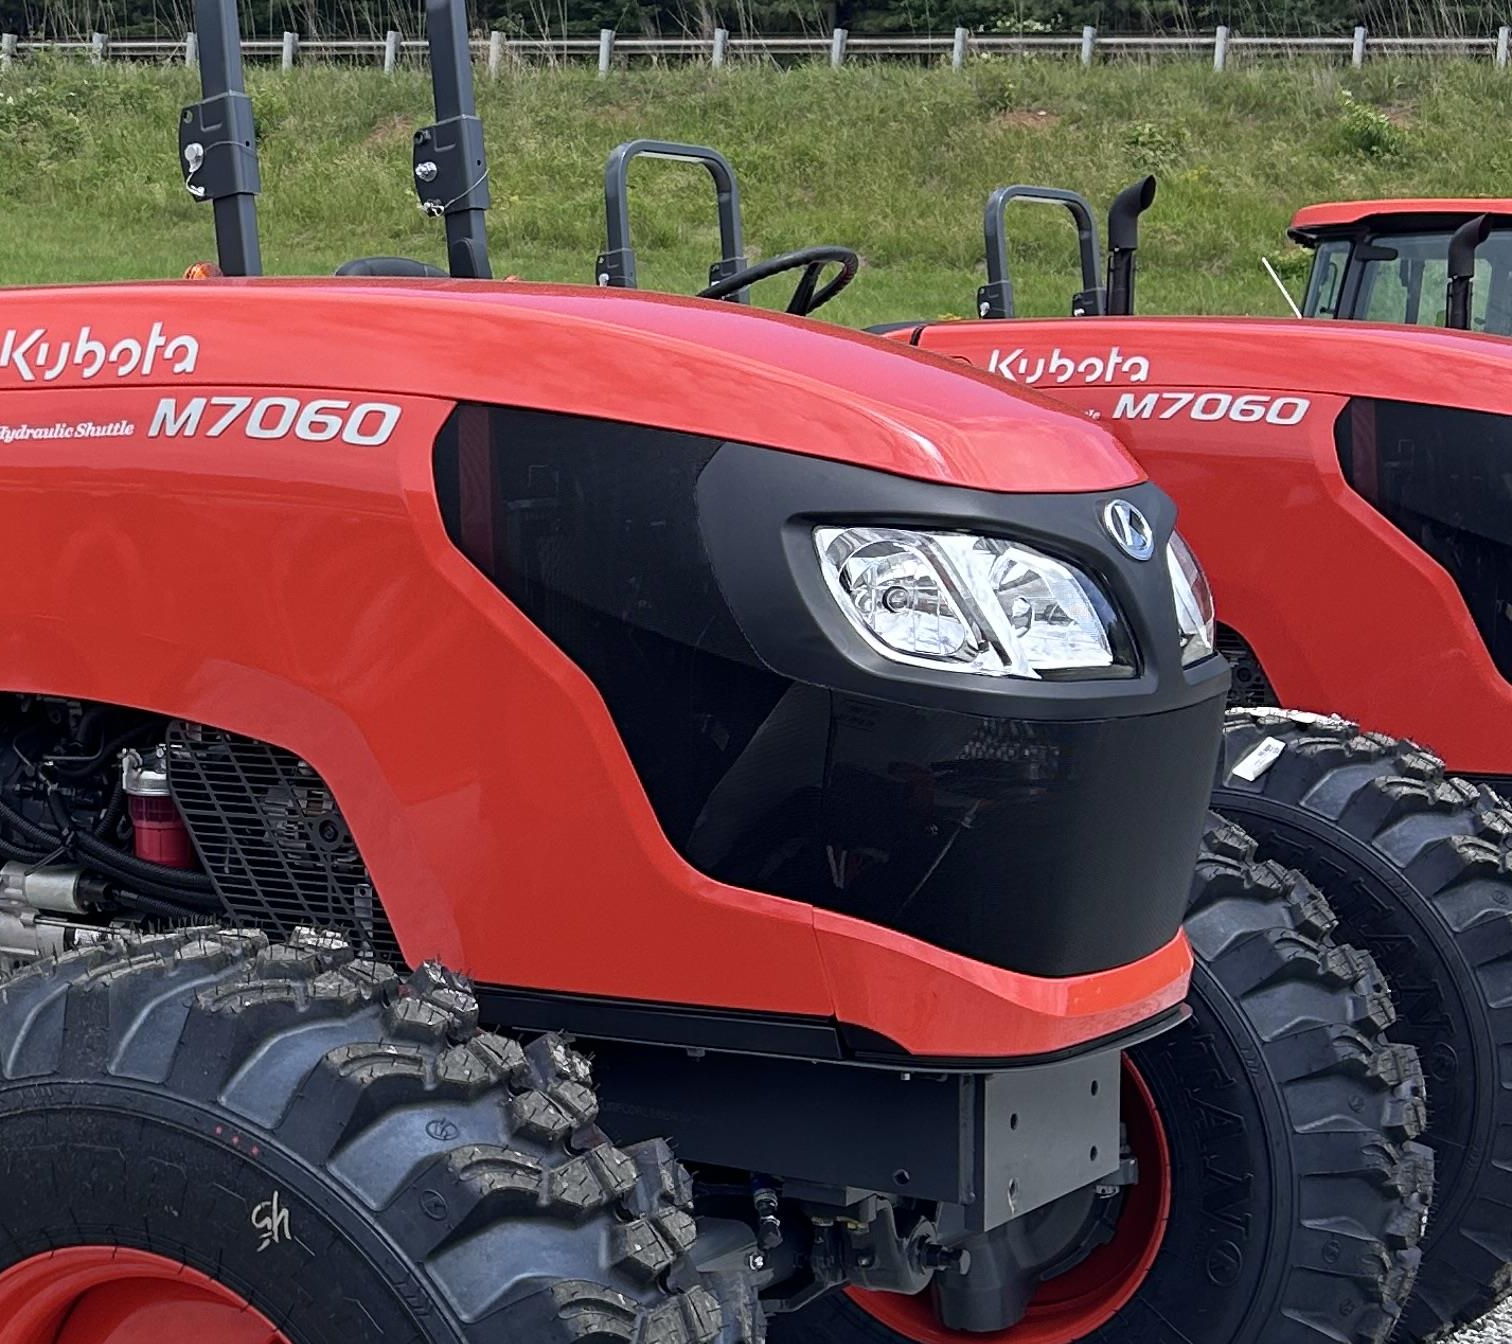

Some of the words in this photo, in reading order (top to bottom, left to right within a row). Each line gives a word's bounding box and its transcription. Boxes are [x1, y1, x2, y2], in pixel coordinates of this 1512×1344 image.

[988, 346, 1150, 384] Kubota
[74, 420, 135, 438] Shuttle
[147, 396, 403, 447] M7060
[1112, 392, 1311, 426] M7060
